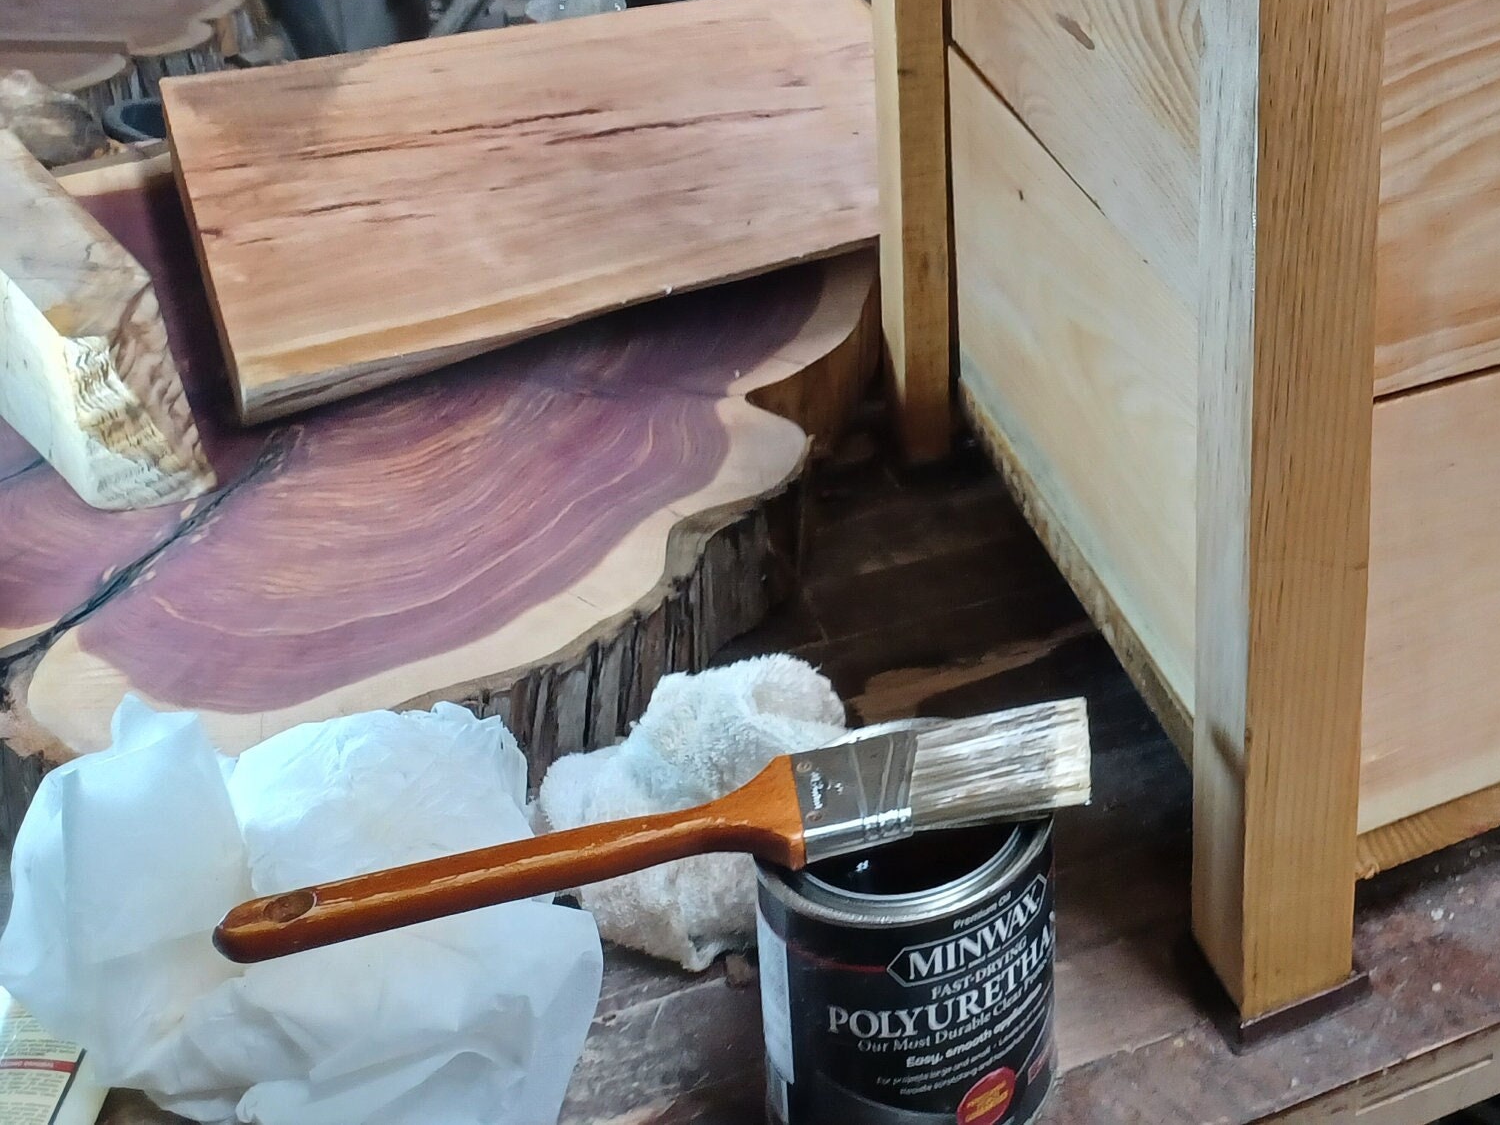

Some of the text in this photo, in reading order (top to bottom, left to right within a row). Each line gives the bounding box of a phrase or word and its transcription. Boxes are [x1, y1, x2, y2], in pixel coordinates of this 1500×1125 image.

[909, 884, 1040, 980] MINWAX
[953, 901, 998, 930] Premium
[827, 924, 1053, 1039] POLYURETHA
[931, 935, 1028, 1000] FAST-DRYING
[858, 1039, 888, 1053] Our
[893, 1037, 931, 1052] Most
[935, 1013, 991, 1044] Durable
